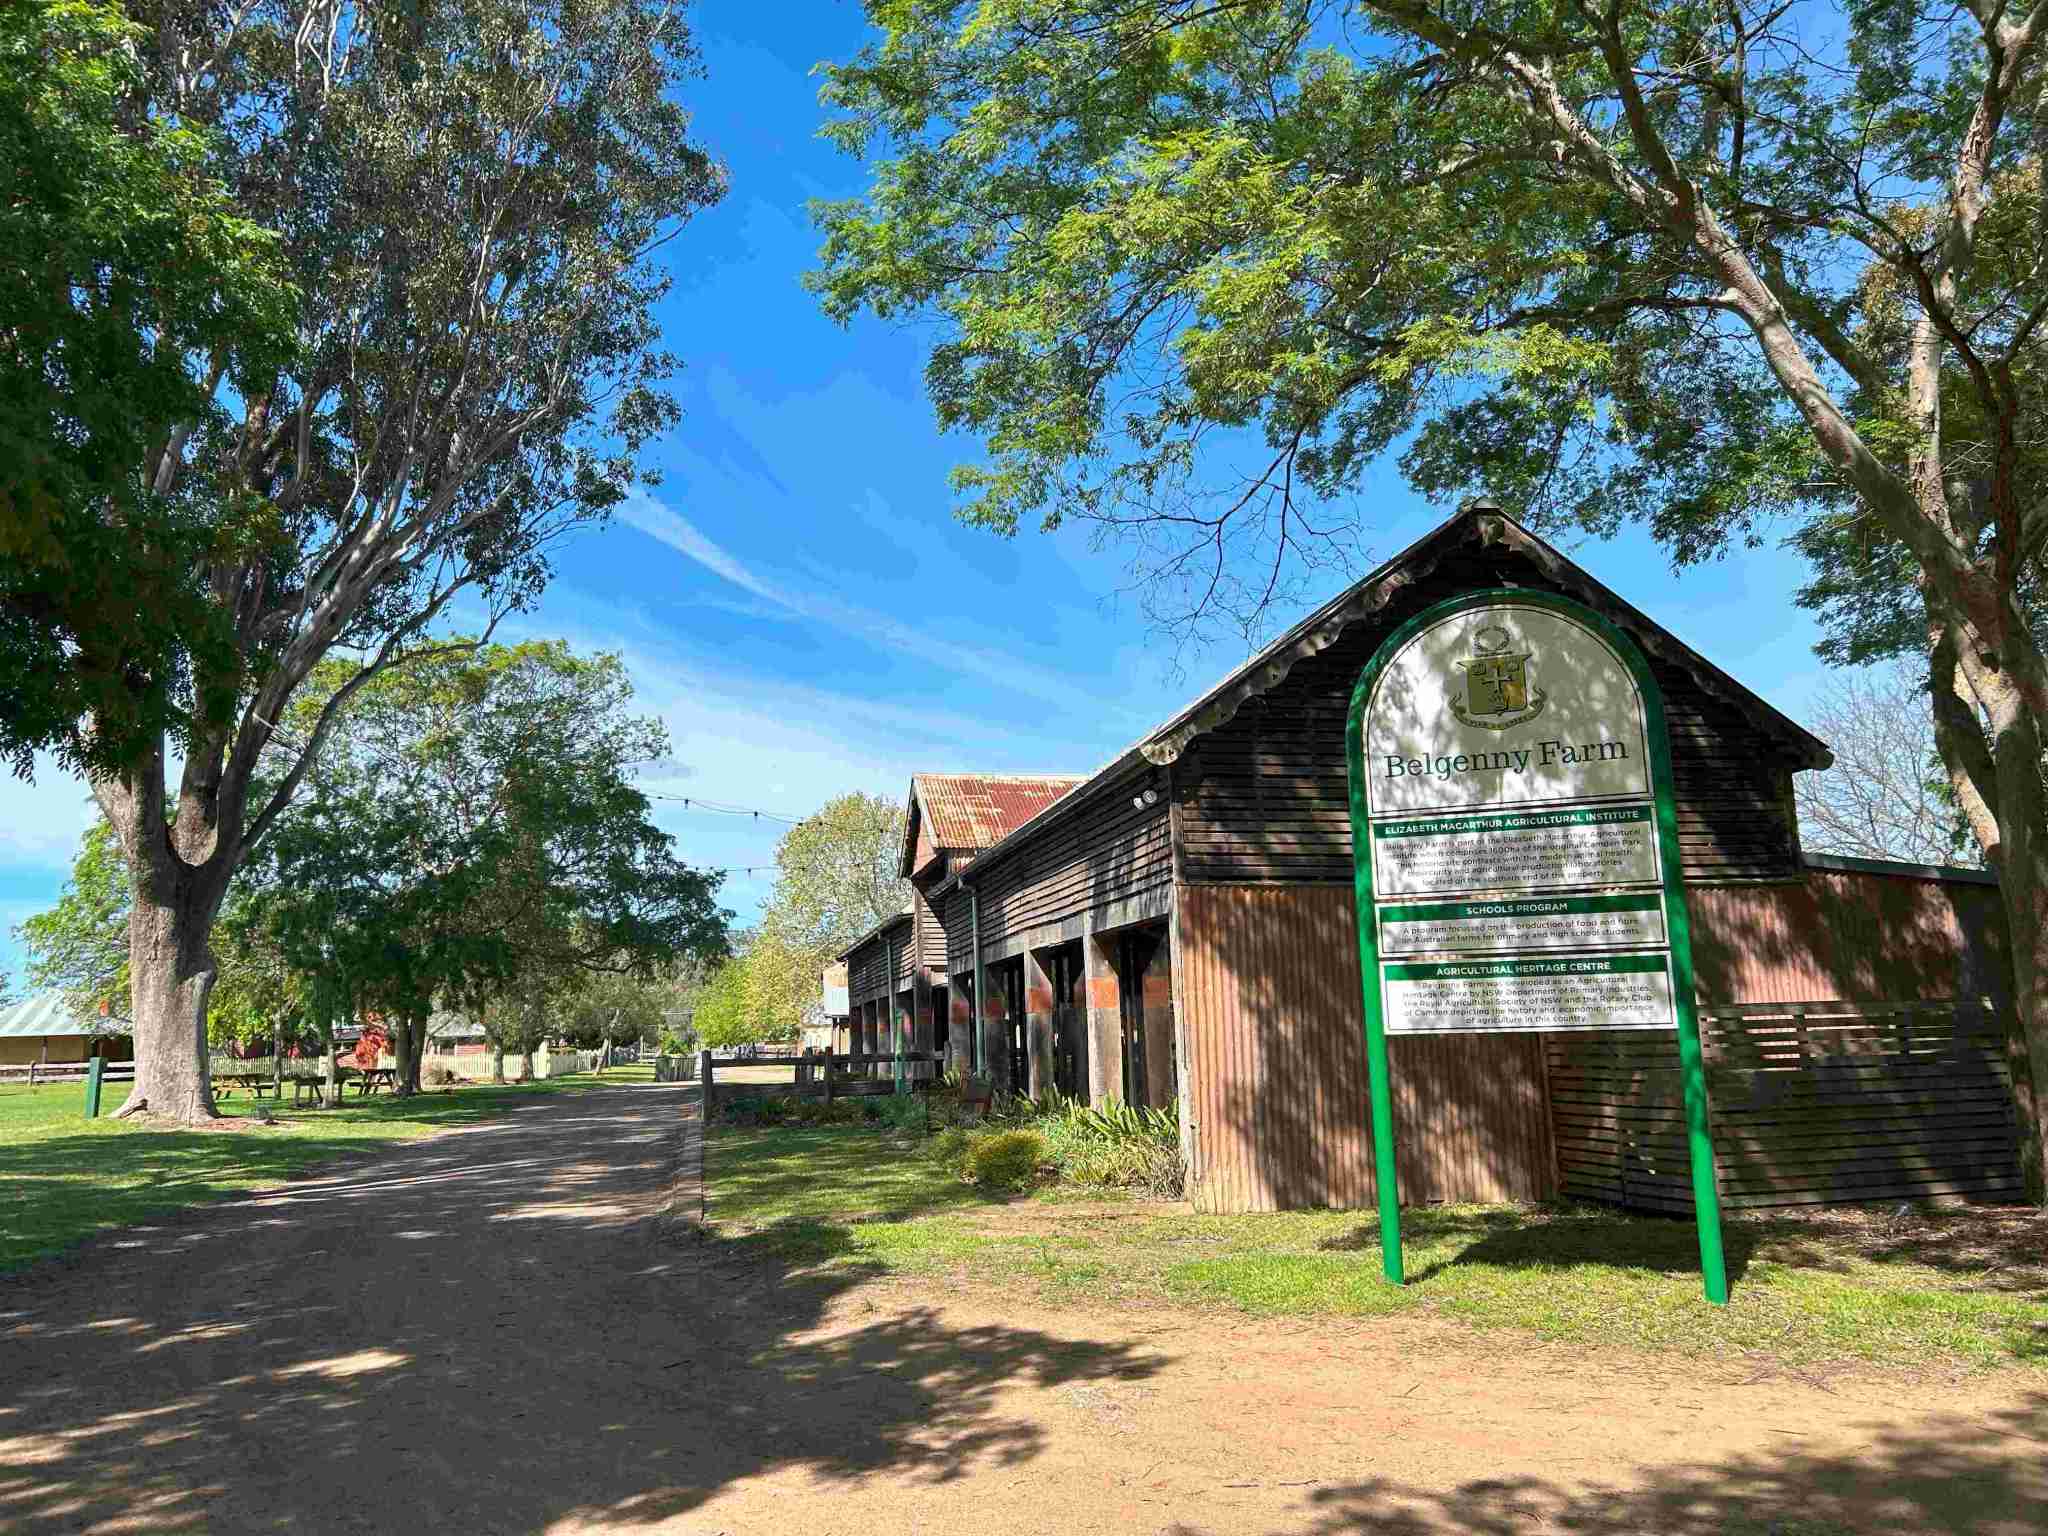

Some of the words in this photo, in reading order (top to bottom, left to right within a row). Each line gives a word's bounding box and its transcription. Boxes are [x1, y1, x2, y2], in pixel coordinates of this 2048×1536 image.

[1384, 750, 1532, 780] Belgenny
[1538, 739, 1629, 765] Farm
[1385, 824, 1438, 834] ELIZABETH
[1440, 820, 1502, 830] MACARTHUR
[1505, 814, 1584, 826] AGRICULTURAL
[1586, 810, 1639, 821] INSTITUTE
[1590, 828, 1641, 839] Agricultural
[1550, 841, 1581, 852] original
[1583, 839, 1619, 848] Camden
[1462, 856, 1500, 865] contrasts
[1502, 855, 1521, 863] with
[1471, 865, 1519, 875] agricultural
[1465, 905, 1514, 915] SCHOOLS
[1517, 903, 1568, 913] PROGRAM
[1516, 921, 1563, 931] production
[1571, 928, 1600, 936] school
[1436, 966, 1513, 976] AGRICULTURAL
[1516, 964, 1566, 973] HERITAGE
[1570, 961, 1611, 971] CENTRE
[1577, 976, 1628, 985] Agricultural
[1495, 997, 1526, 1006] Society
